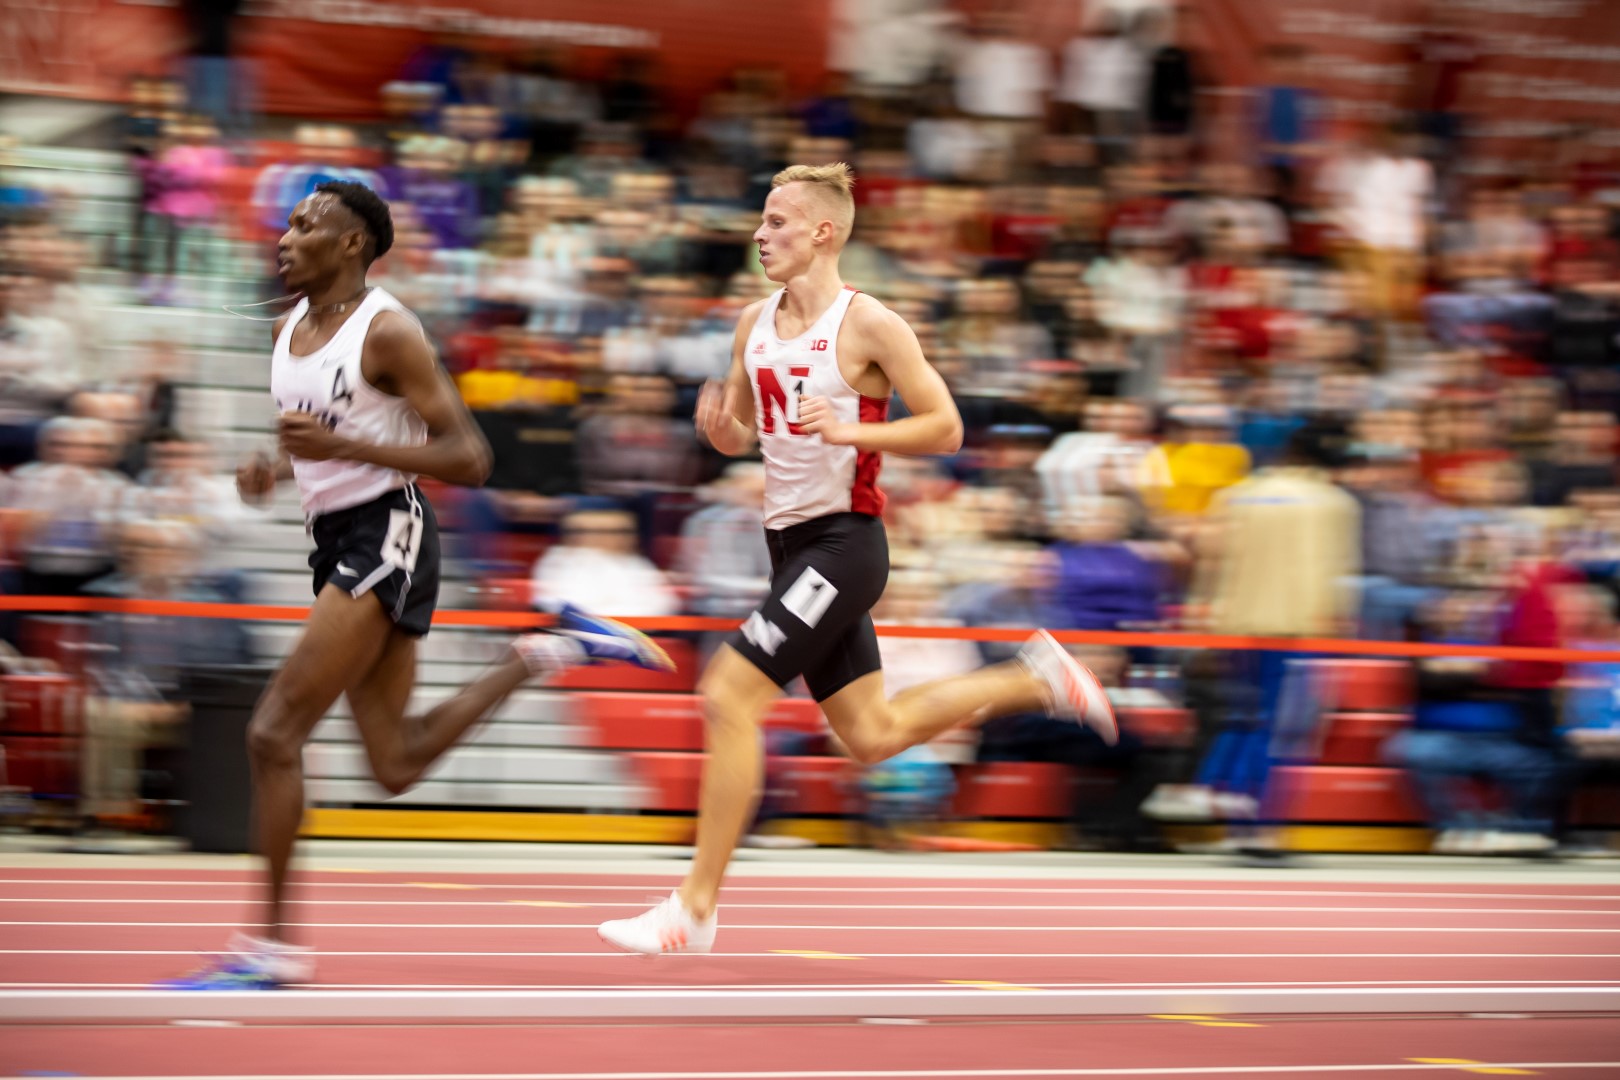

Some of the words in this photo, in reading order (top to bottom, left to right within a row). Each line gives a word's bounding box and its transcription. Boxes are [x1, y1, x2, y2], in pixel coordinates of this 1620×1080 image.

[331, 365, 354, 406] 4
[755, 365, 813, 437] N
[393, 520, 415, 559] 4
